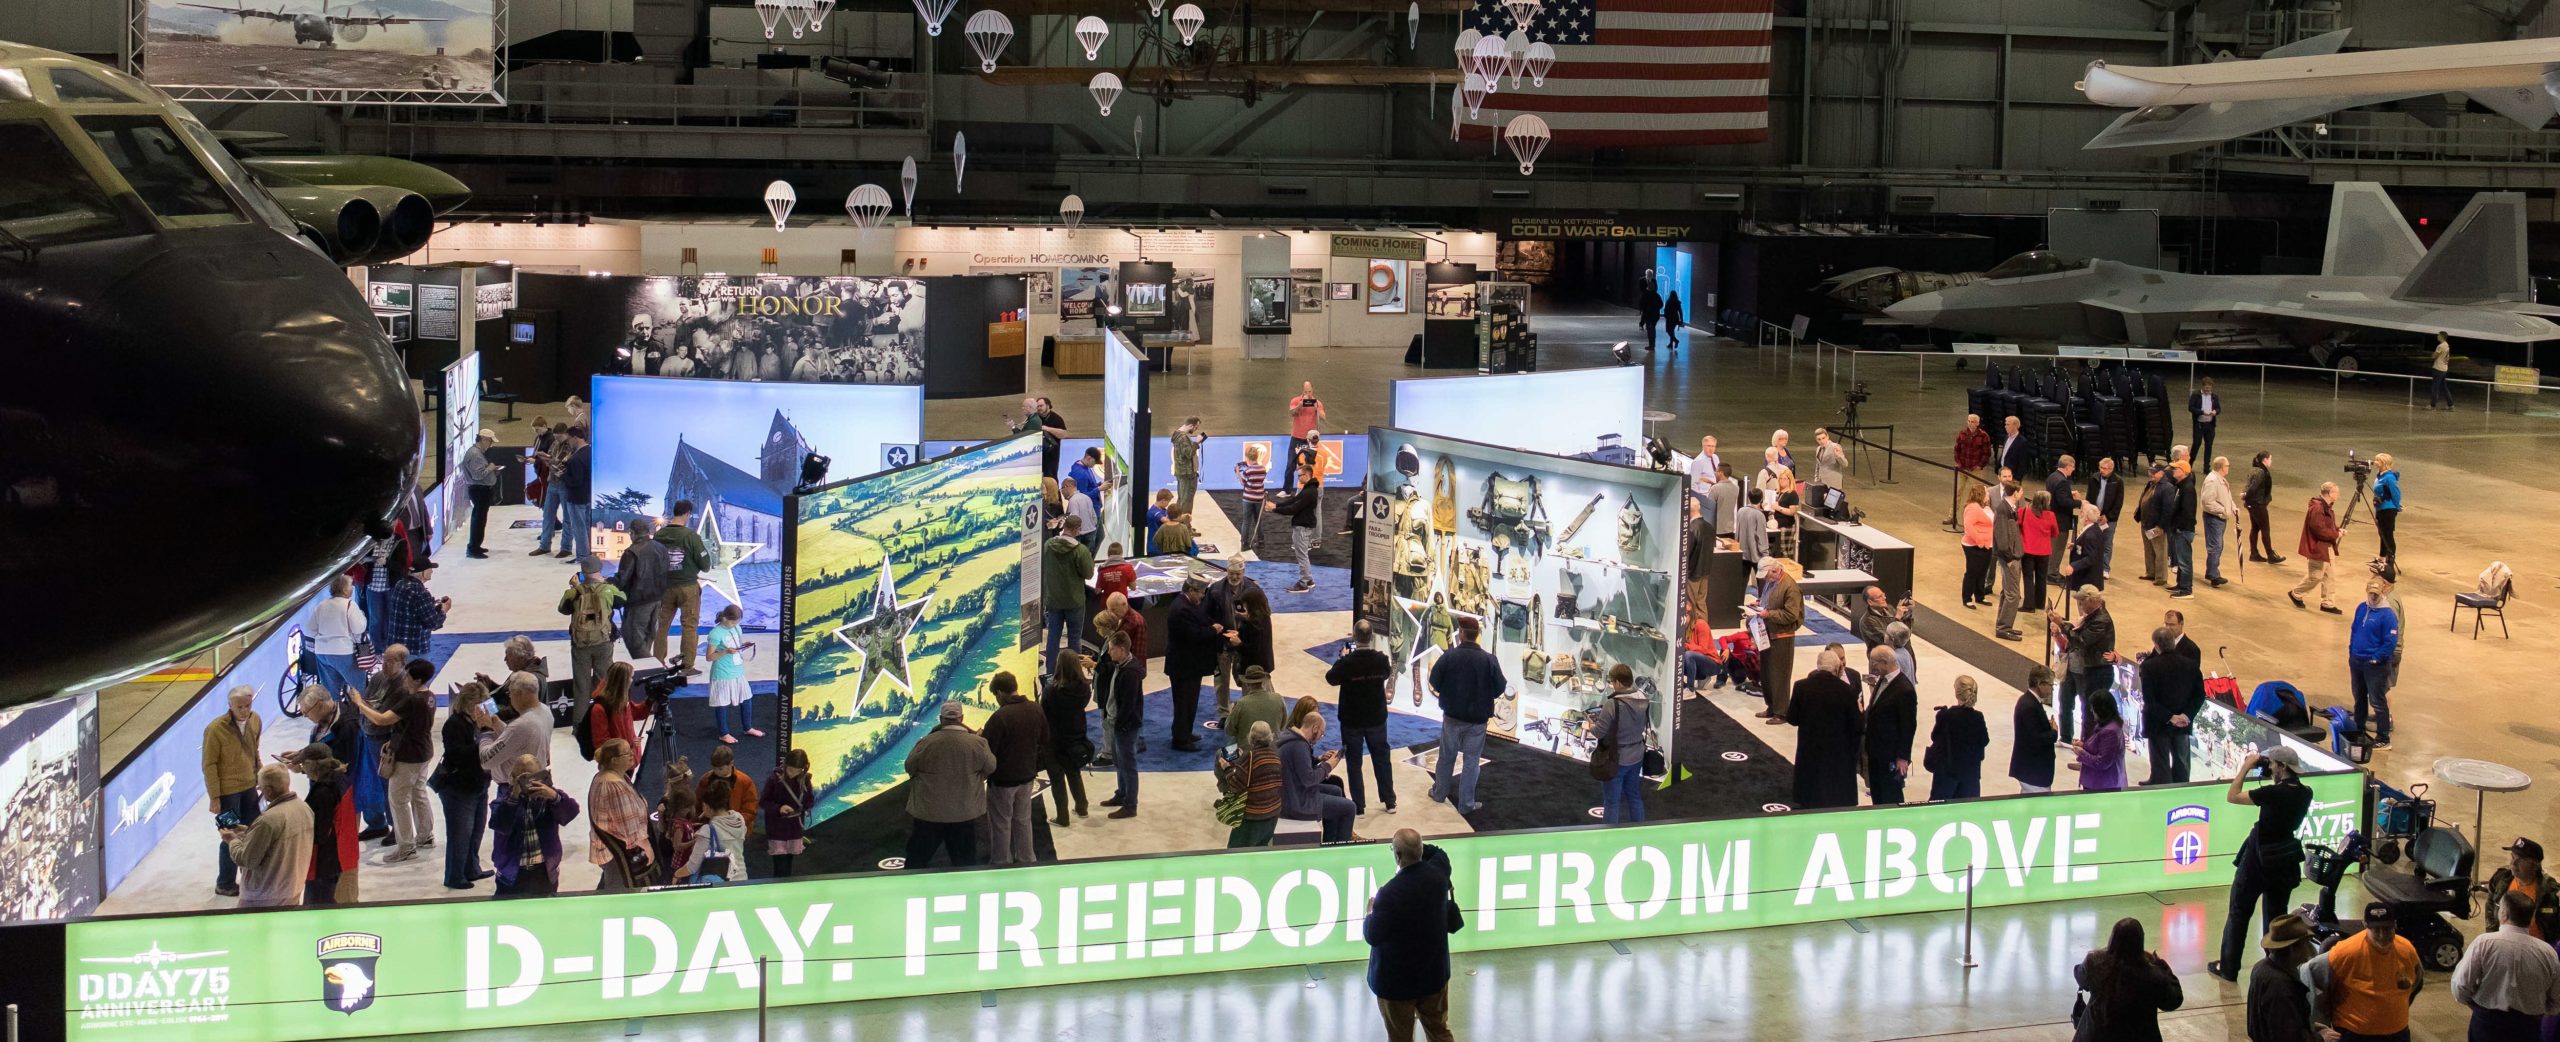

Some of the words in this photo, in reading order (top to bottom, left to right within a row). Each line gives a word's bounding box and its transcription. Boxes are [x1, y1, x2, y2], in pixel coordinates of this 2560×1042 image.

[1512, 225, 1560, 236] COLD
[1565, 226, 1608, 237] WAR
[1611, 226, 1691, 237] GALLERY
[1334, 236, 1379, 248] COMING
[974, 253, 1026, 265] Operation
[1031, 253, 1109, 264] HOMECOMING
[720, 286, 762, 296] RETURN
[737, 295, 846, 316] HONOR
[1069, 307, 1088, 315] HOME
[783, 565, 792, 642] PATHFINDERS
[1674, 655, 1683, 730] PARATROOPER
[780, 694, 789, 752] AIRBORNE
[2171, 807, 2207, 821] AIRBORNE
[466, 903, 854, 1009] D-DAY:
[1477, 839, 1752, 932] FROM
[1794, 813, 2102, 906] ABOVE
[322, 936, 377, 952] AIRBORNE
[79, 967, 230, 1002] DDAY75
[80, 996, 229, 1019] ANNIVERSARY
